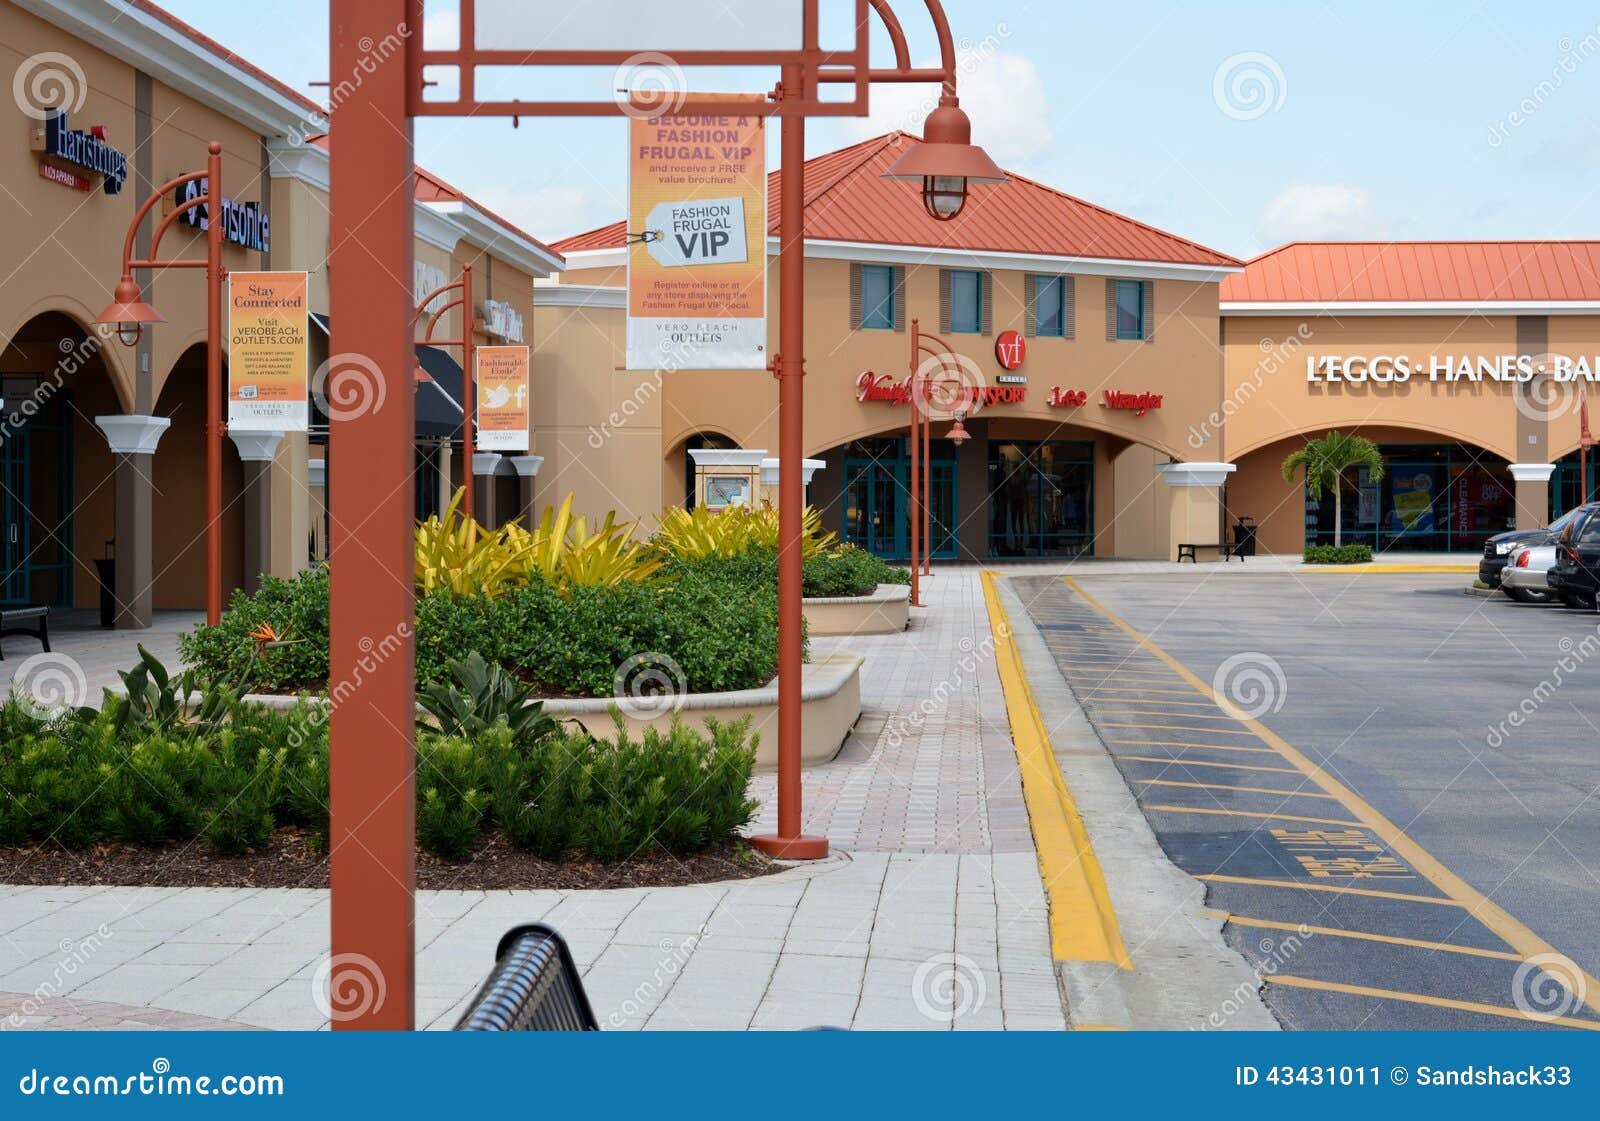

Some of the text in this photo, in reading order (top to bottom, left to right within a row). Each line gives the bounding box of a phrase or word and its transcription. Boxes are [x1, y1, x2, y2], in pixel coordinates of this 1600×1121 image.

[648, 115, 749, 127] BECOME A
[657, 129, 739, 143] FASHION
[56, 107, 128, 193] Hartstrings
[639, 146, 753, 160] FRUGAL VIP
[649, 164, 668, 173] and
[670, 164, 707, 173] receive
[718, 164, 746, 173] FREE
[658, 176, 737, 184] value brochure!
[200, 177, 270, 252] Smsonite
[672, 205, 730, 220] FASHION
[673, 217, 732, 232] FRUGAL
[675, 231, 730, 259] VIP
[248, 284, 275, 297] Stay
[654, 281, 740, 291] Register online or at
[234, 296, 302, 308] Connected
[646, 292, 662, 301] any
[663, 291, 687, 300] store
[641, 301, 676, 310] Fashion
[678, 301, 706, 311] Frugal
[258, 318, 278, 327] Visit
[656, 323, 690, 332] VERO
[237, 327, 300, 336] VEROBEACH
[232, 336, 305, 345] OUTLETS.COM
[671, 333, 722, 343] OUTLETS
[1428, 354, 1534, 383] HANES
[1051, 386, 1088, 408] Lee
[1103, 390, 1164, 417] Wrangler
[1459, 478, 1468, 537] CLEARANCE
